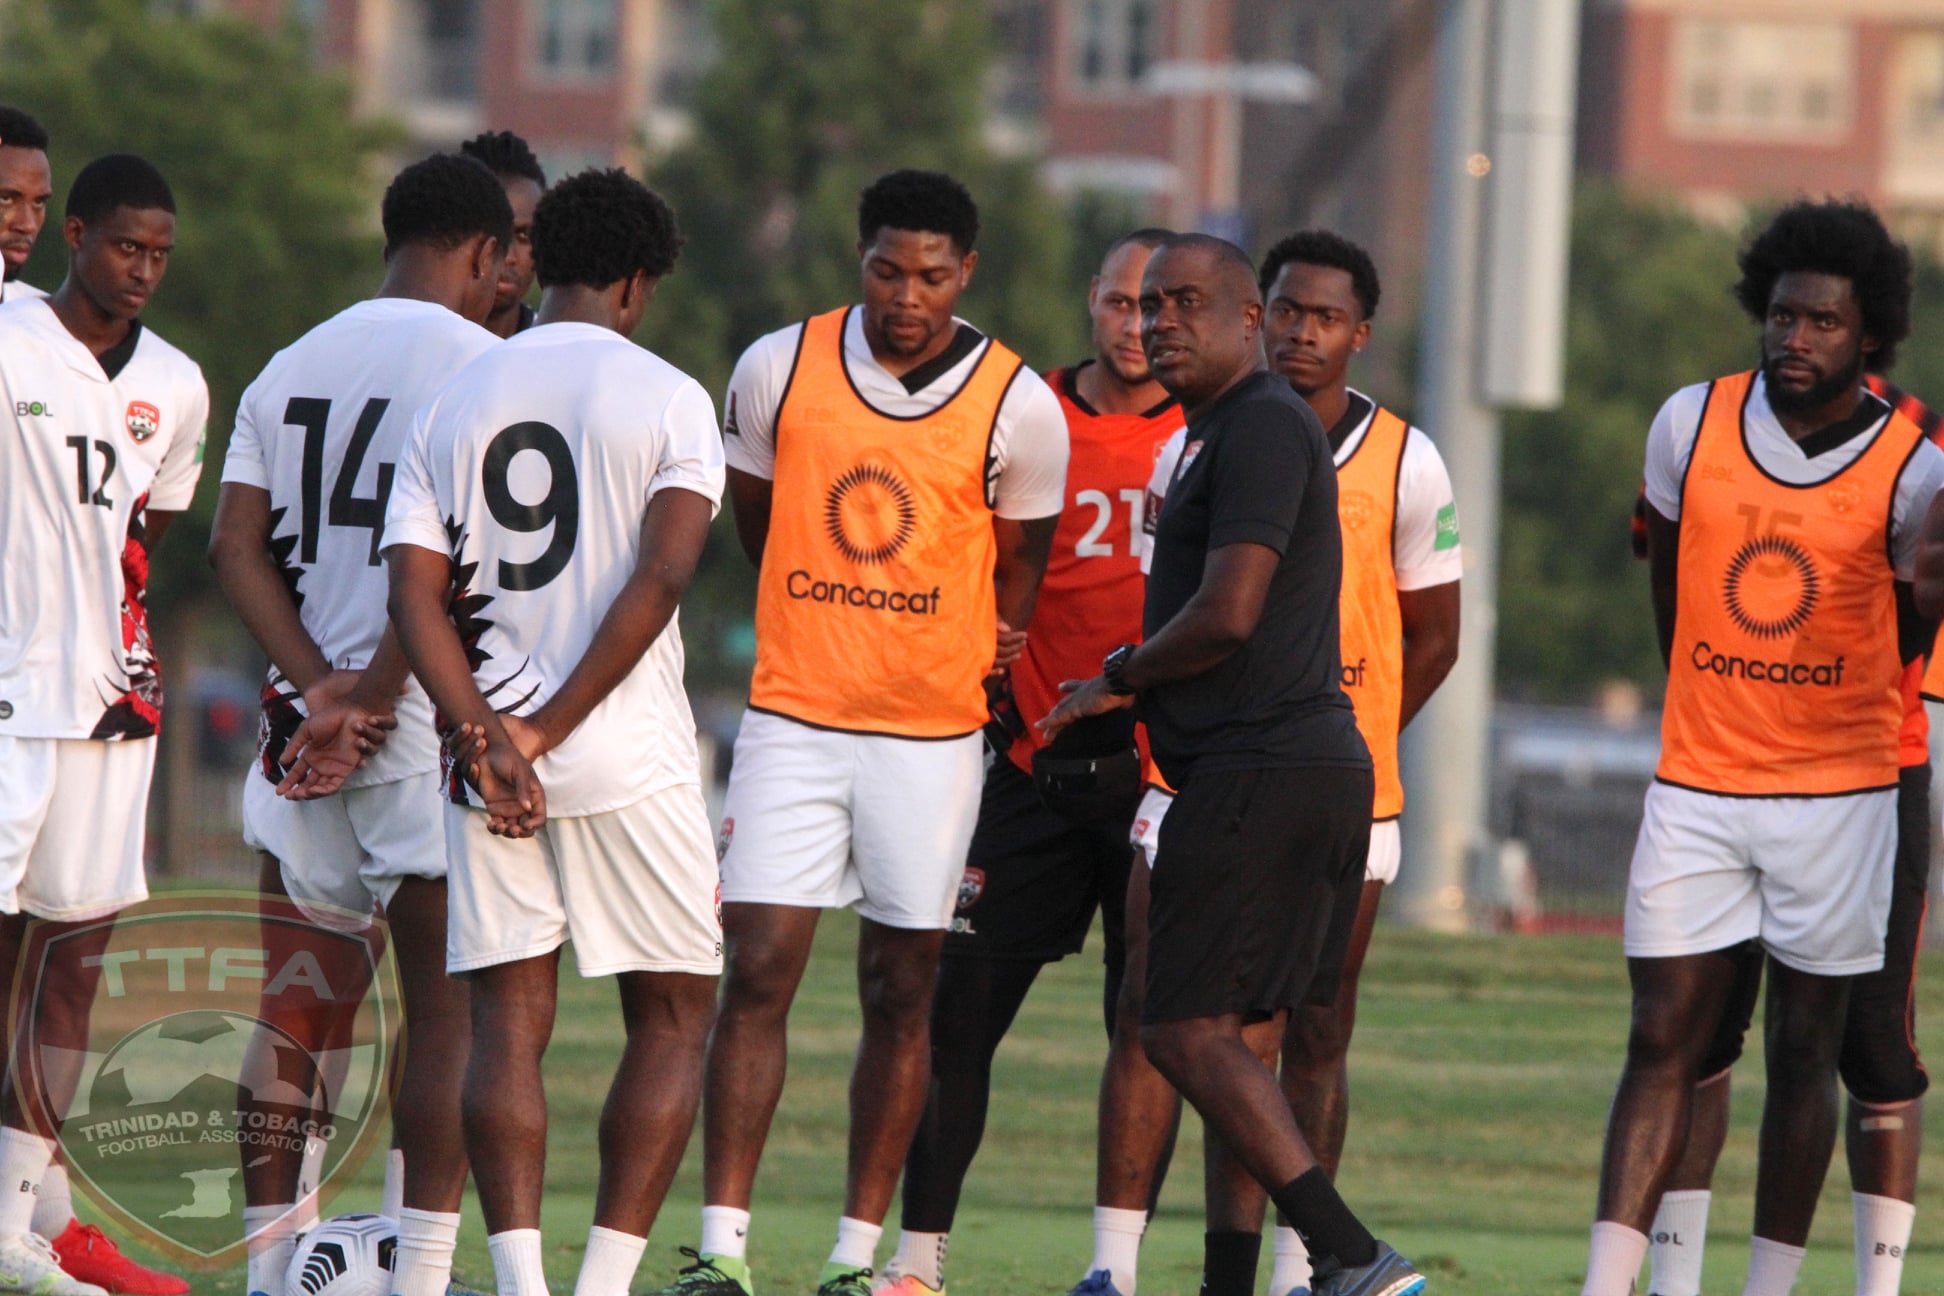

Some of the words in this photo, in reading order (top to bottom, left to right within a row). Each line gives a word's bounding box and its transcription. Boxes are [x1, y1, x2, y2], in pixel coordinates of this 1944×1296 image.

[16, 401, 53, 417] BOL
[66, 435, 117, 511] 12
[283, 397, 395, 566] 14
[482, 420, 579, 592] 9
[1074, 489, 1145, 558] 21
[786, 569, 941, 616] Concacaf
[1691, 641, 1845, 686] Concacaf
